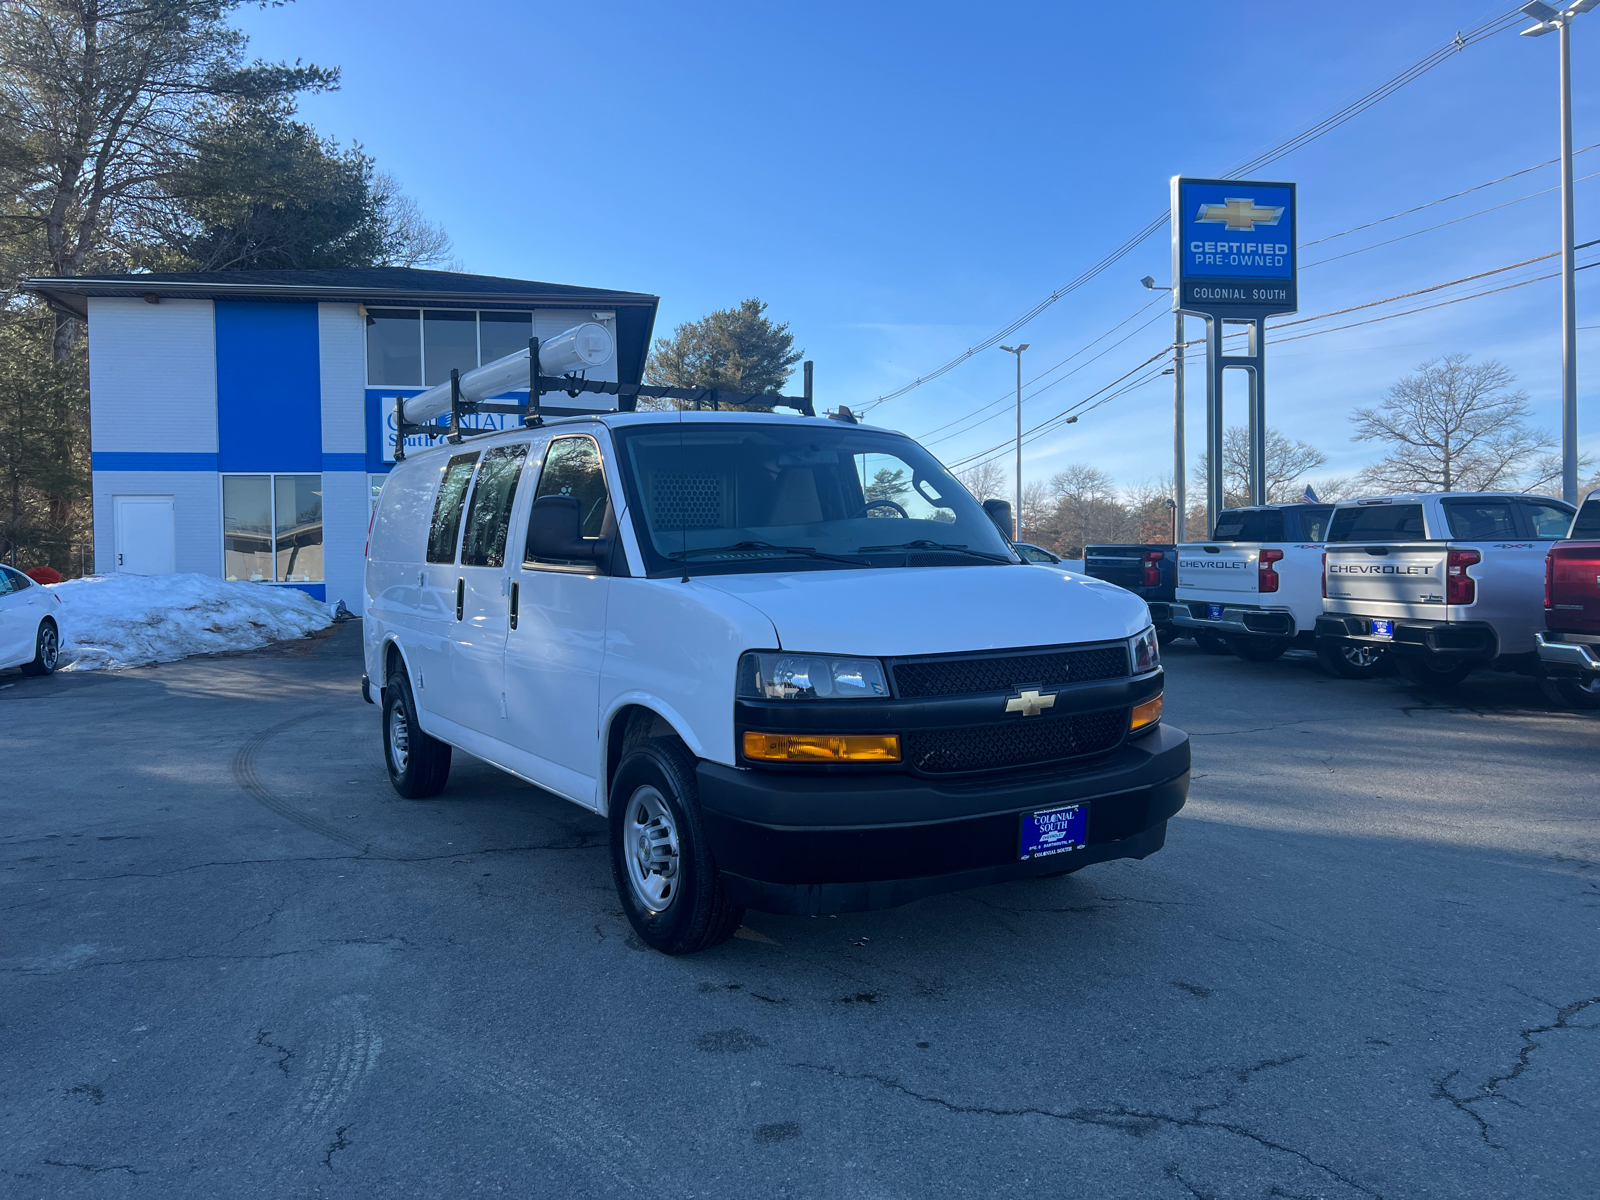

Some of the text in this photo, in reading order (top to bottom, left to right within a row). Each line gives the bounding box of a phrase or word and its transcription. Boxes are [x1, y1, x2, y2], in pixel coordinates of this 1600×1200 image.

[1190, 241, 1288, 255] CERTIFIED
[1195, 254, 1284, 267] PRE-OWNED
[1193, 287, 1286, 300] COLONIAL SOUTH
[1179, 561, 1249, 569] CHEVROLET
[1329, 565, 1433, 575] CHEVROLET
[1034, 811, 1074, 825] COLONIAL
[1040, 821, 1068, 833] SOUTH
[1034, 849, 1056, 858] COLONIAL
